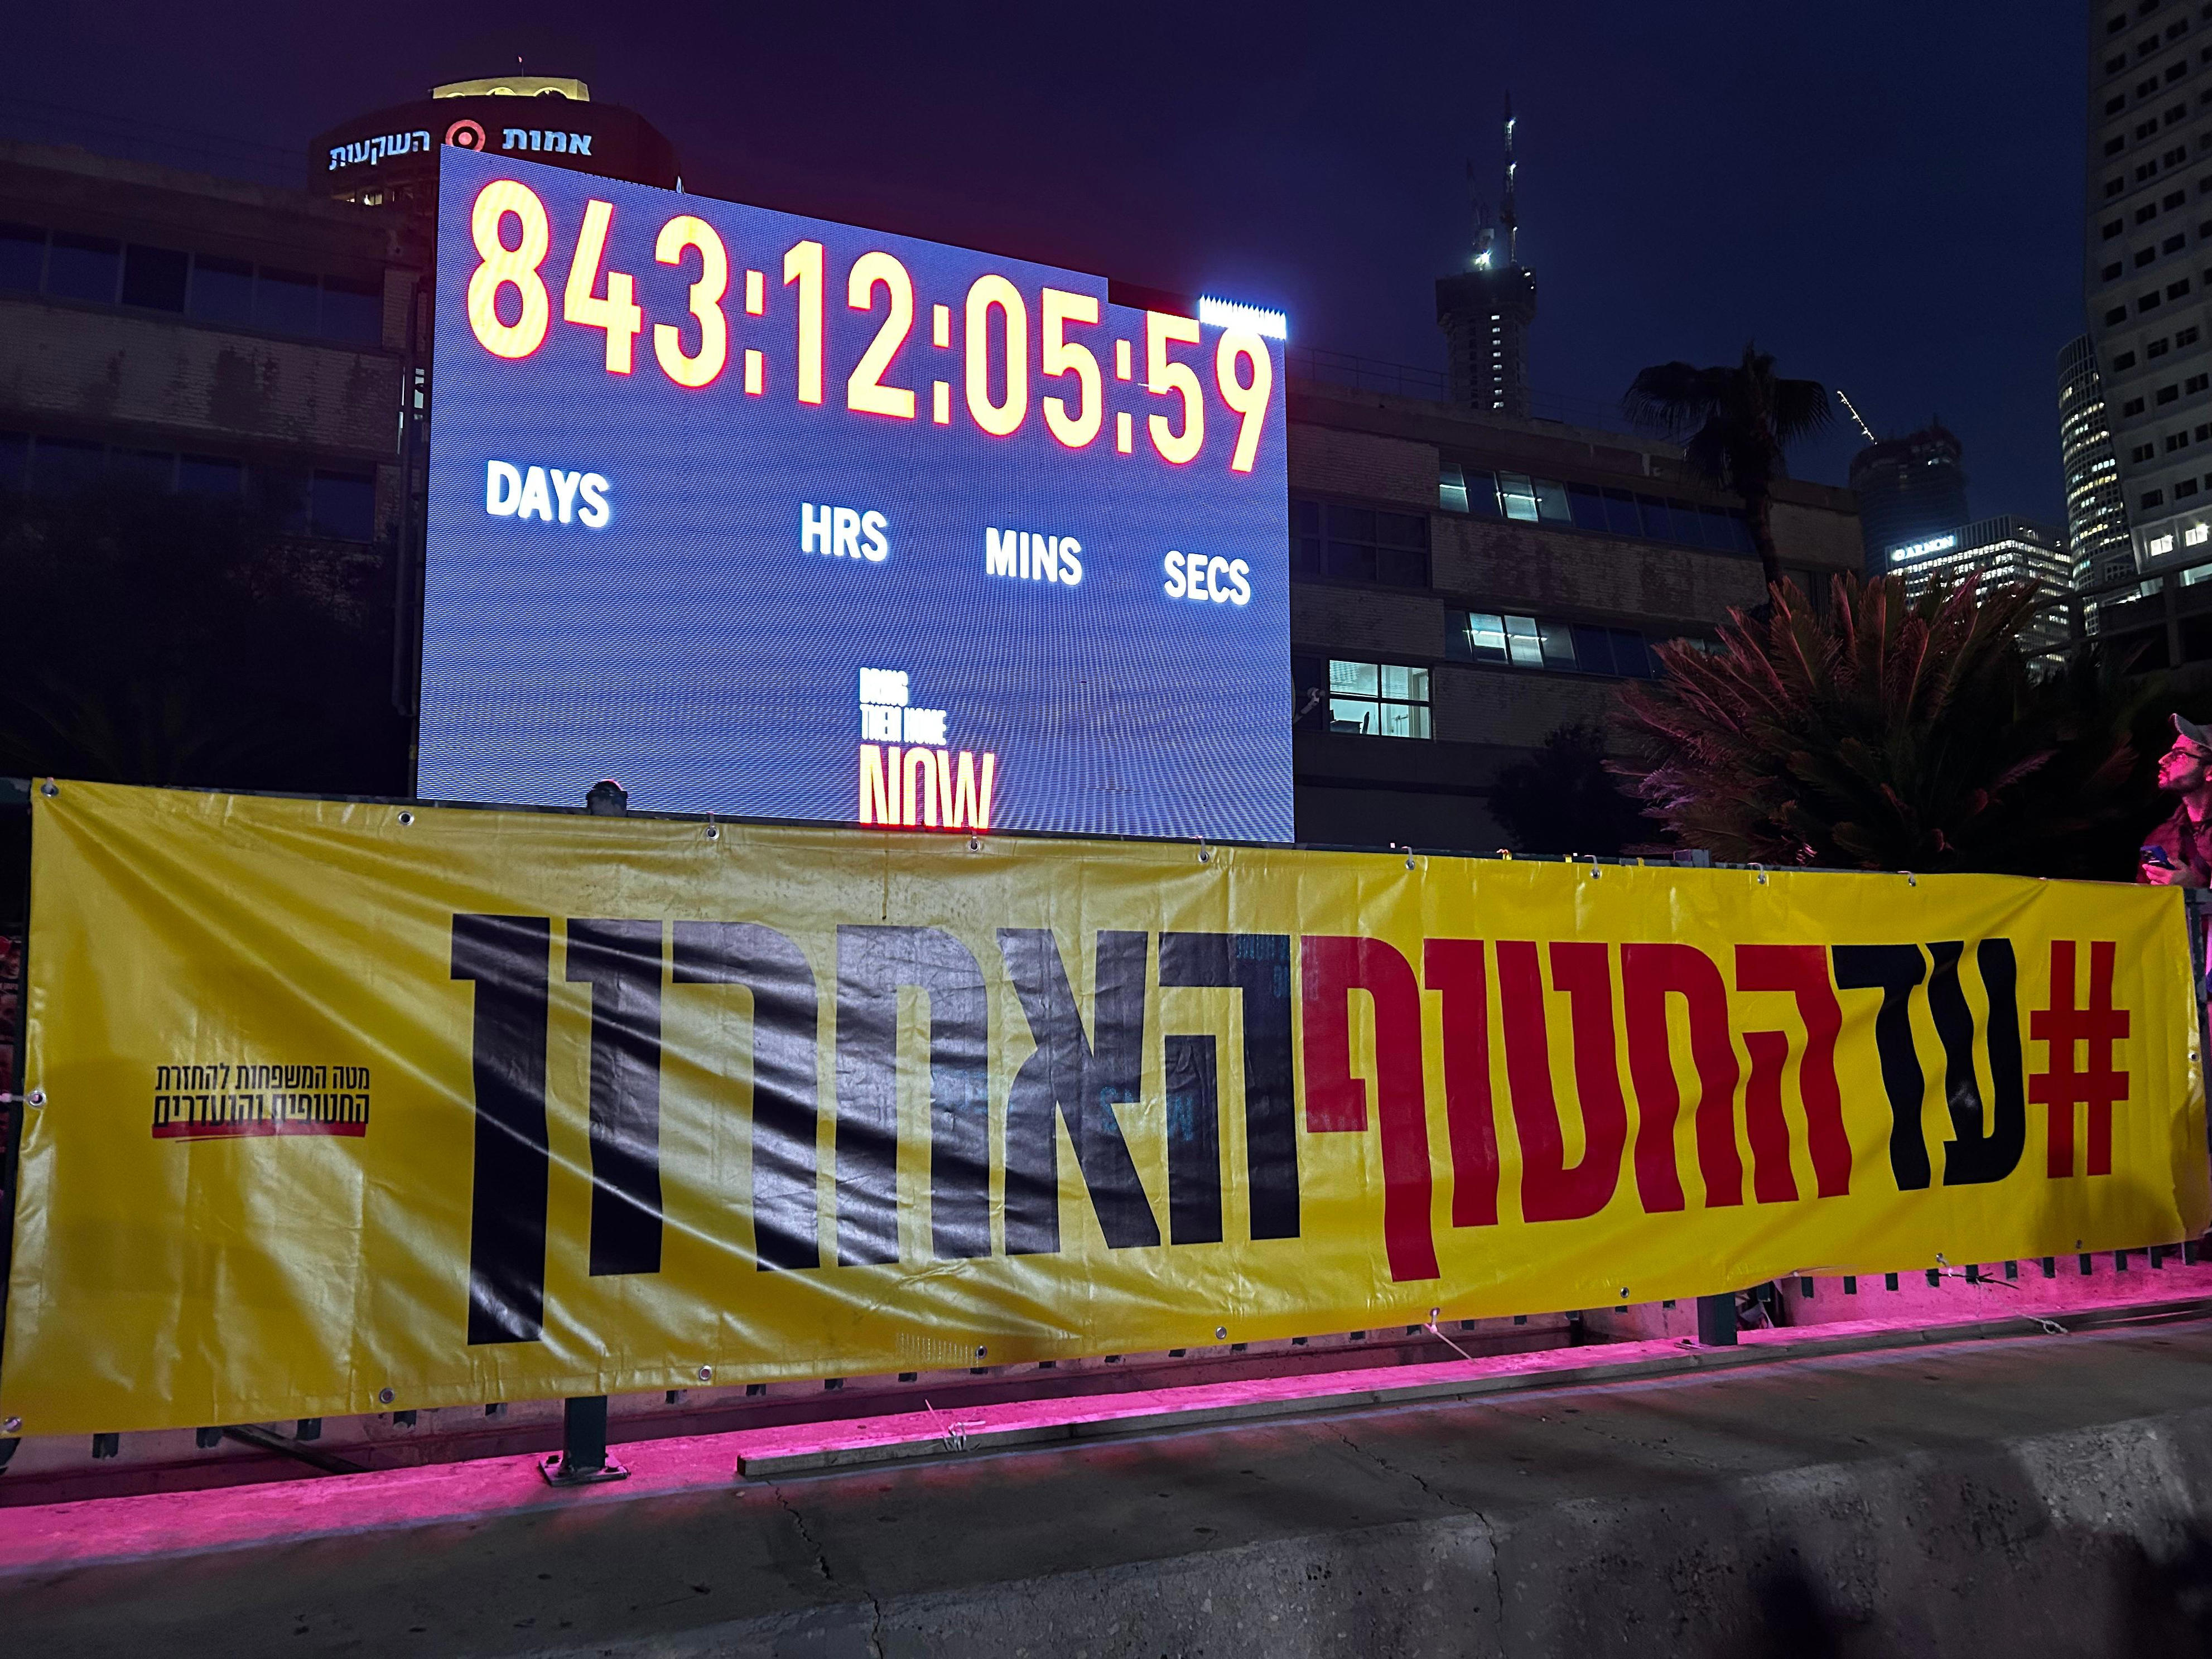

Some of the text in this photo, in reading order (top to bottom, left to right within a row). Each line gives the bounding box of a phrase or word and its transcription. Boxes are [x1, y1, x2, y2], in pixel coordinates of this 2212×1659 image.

[329, 129, 592, 170] אמות השקעות
[486, 459, 1251, 606] DAYS HRS MINS SECS
[860, 744, 995, 829] NOW
[155, 1062, 369, 1090] מטה המשפחות להחזרת
[154, 1094, 369, 1127] החטופים והנעדרים
